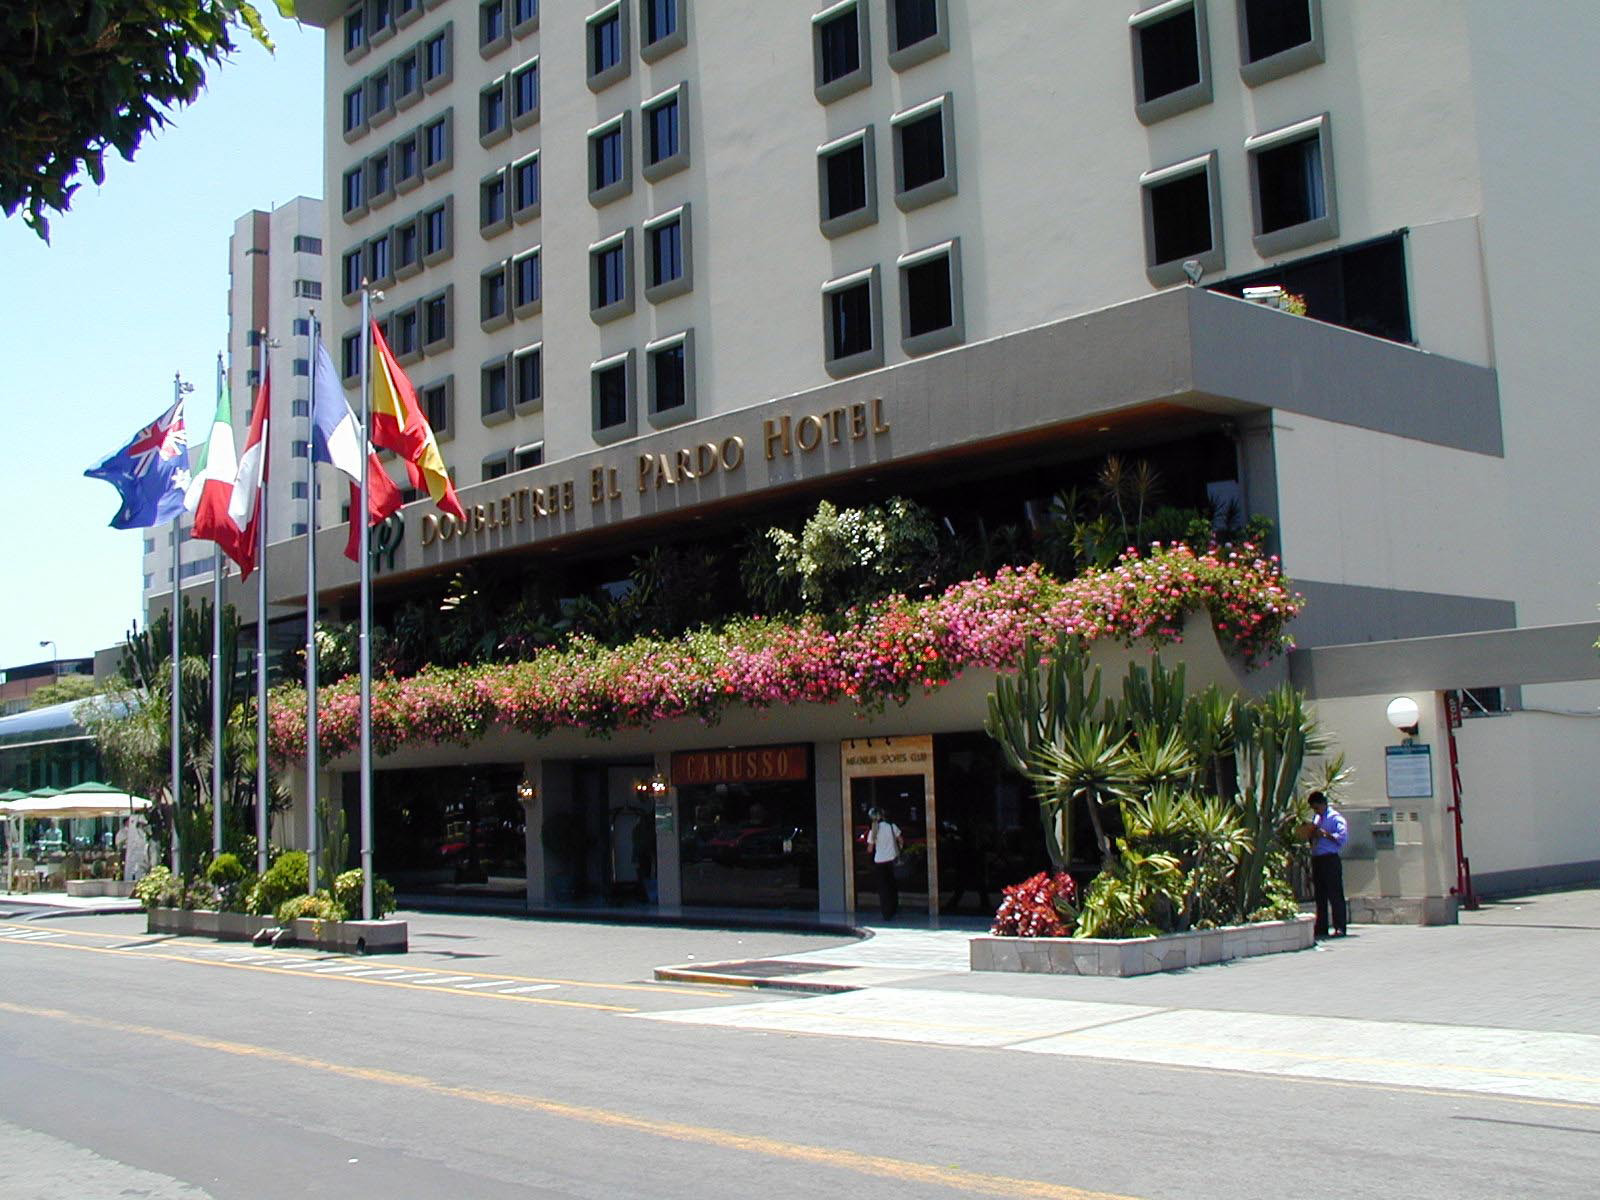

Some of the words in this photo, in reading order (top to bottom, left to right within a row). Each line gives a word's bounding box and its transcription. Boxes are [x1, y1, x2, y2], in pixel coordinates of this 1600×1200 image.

[421, 480, 574, 546] DOUBLETREE
[591, 464, 622, 503] EL
[638, 435, 745, 493] PARDO
[762, 398, 891, 460] HOTEL
[687, 751, 789, 781] CAMUSSO
[910, 752, 927, 762] CLUB
